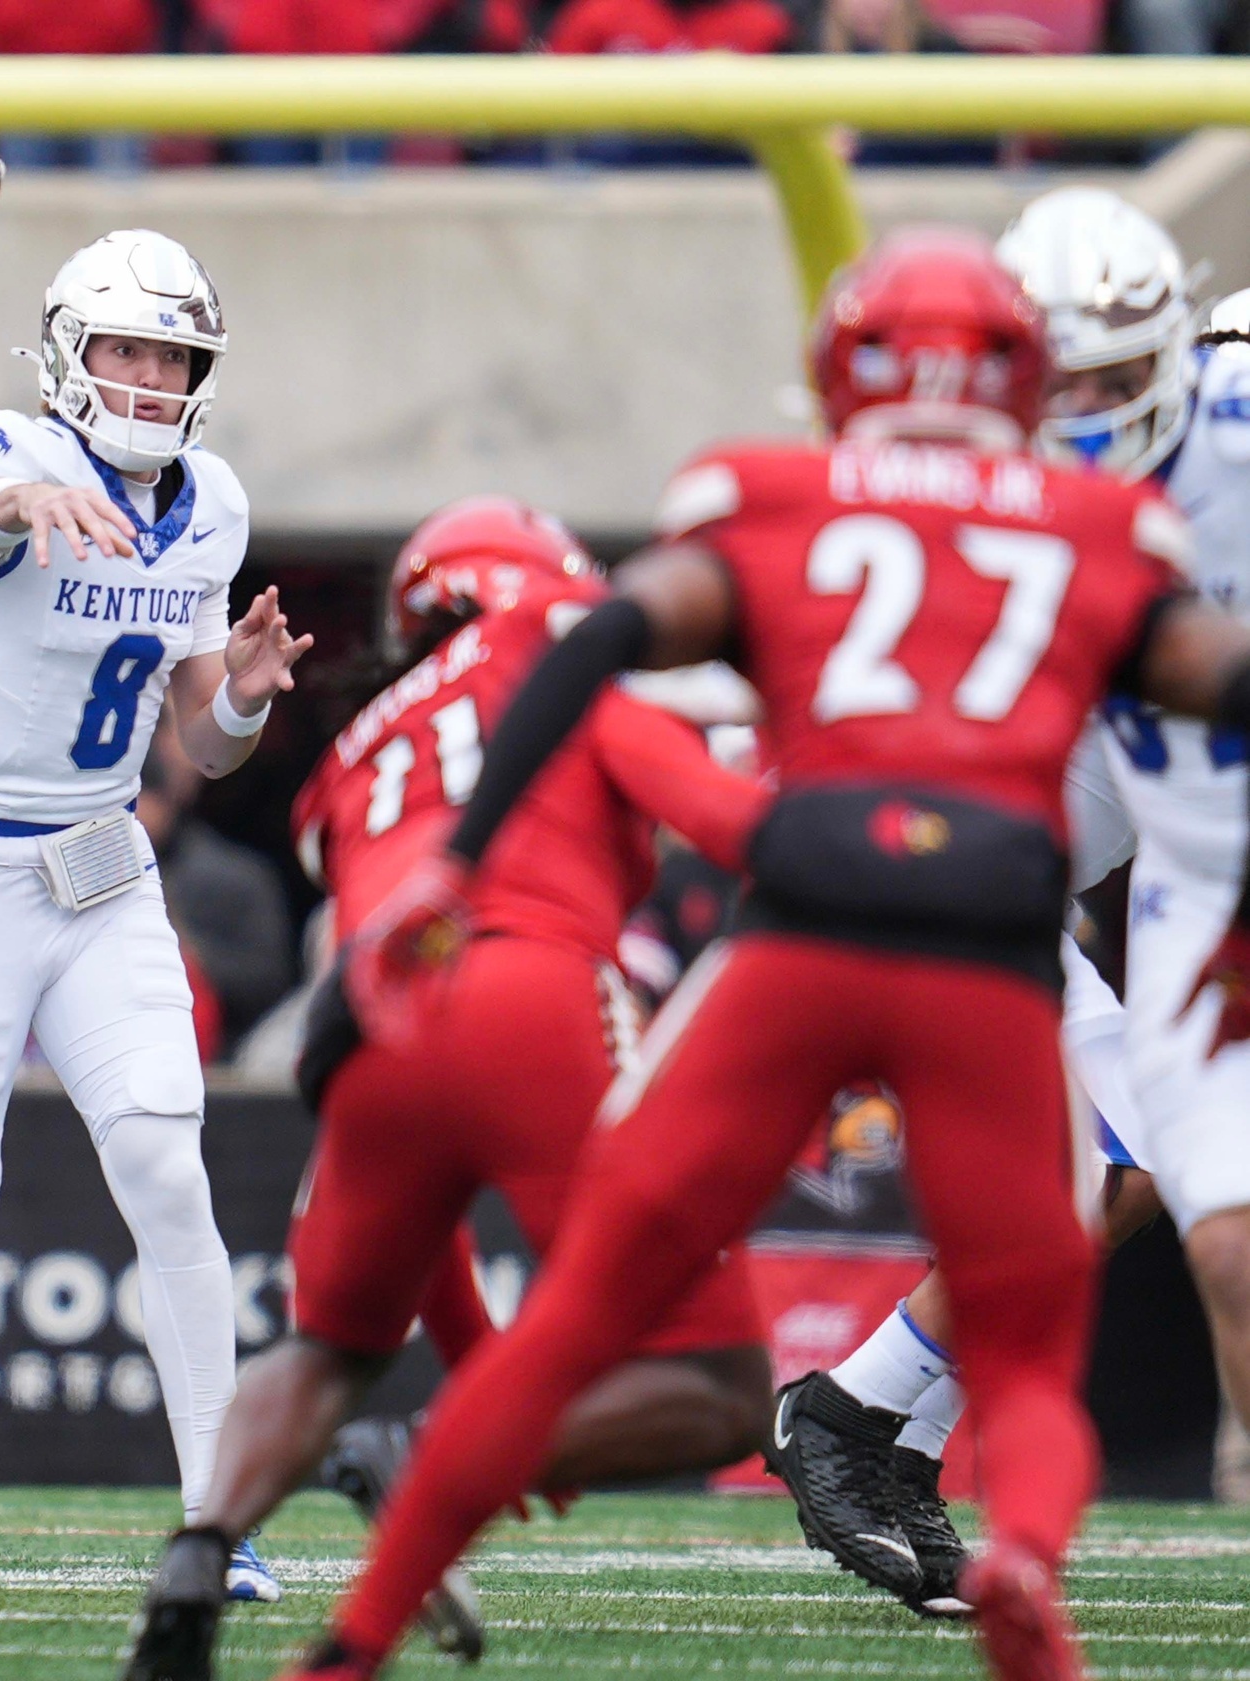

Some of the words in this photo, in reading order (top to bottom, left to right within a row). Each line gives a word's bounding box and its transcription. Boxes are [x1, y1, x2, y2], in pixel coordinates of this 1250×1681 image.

[53, 577, 203, 626] KENTUCK
[805, 511, 1078, 726] 27
[67, 631, 166, 772] 8
[365, 693, 486, 838] 11
